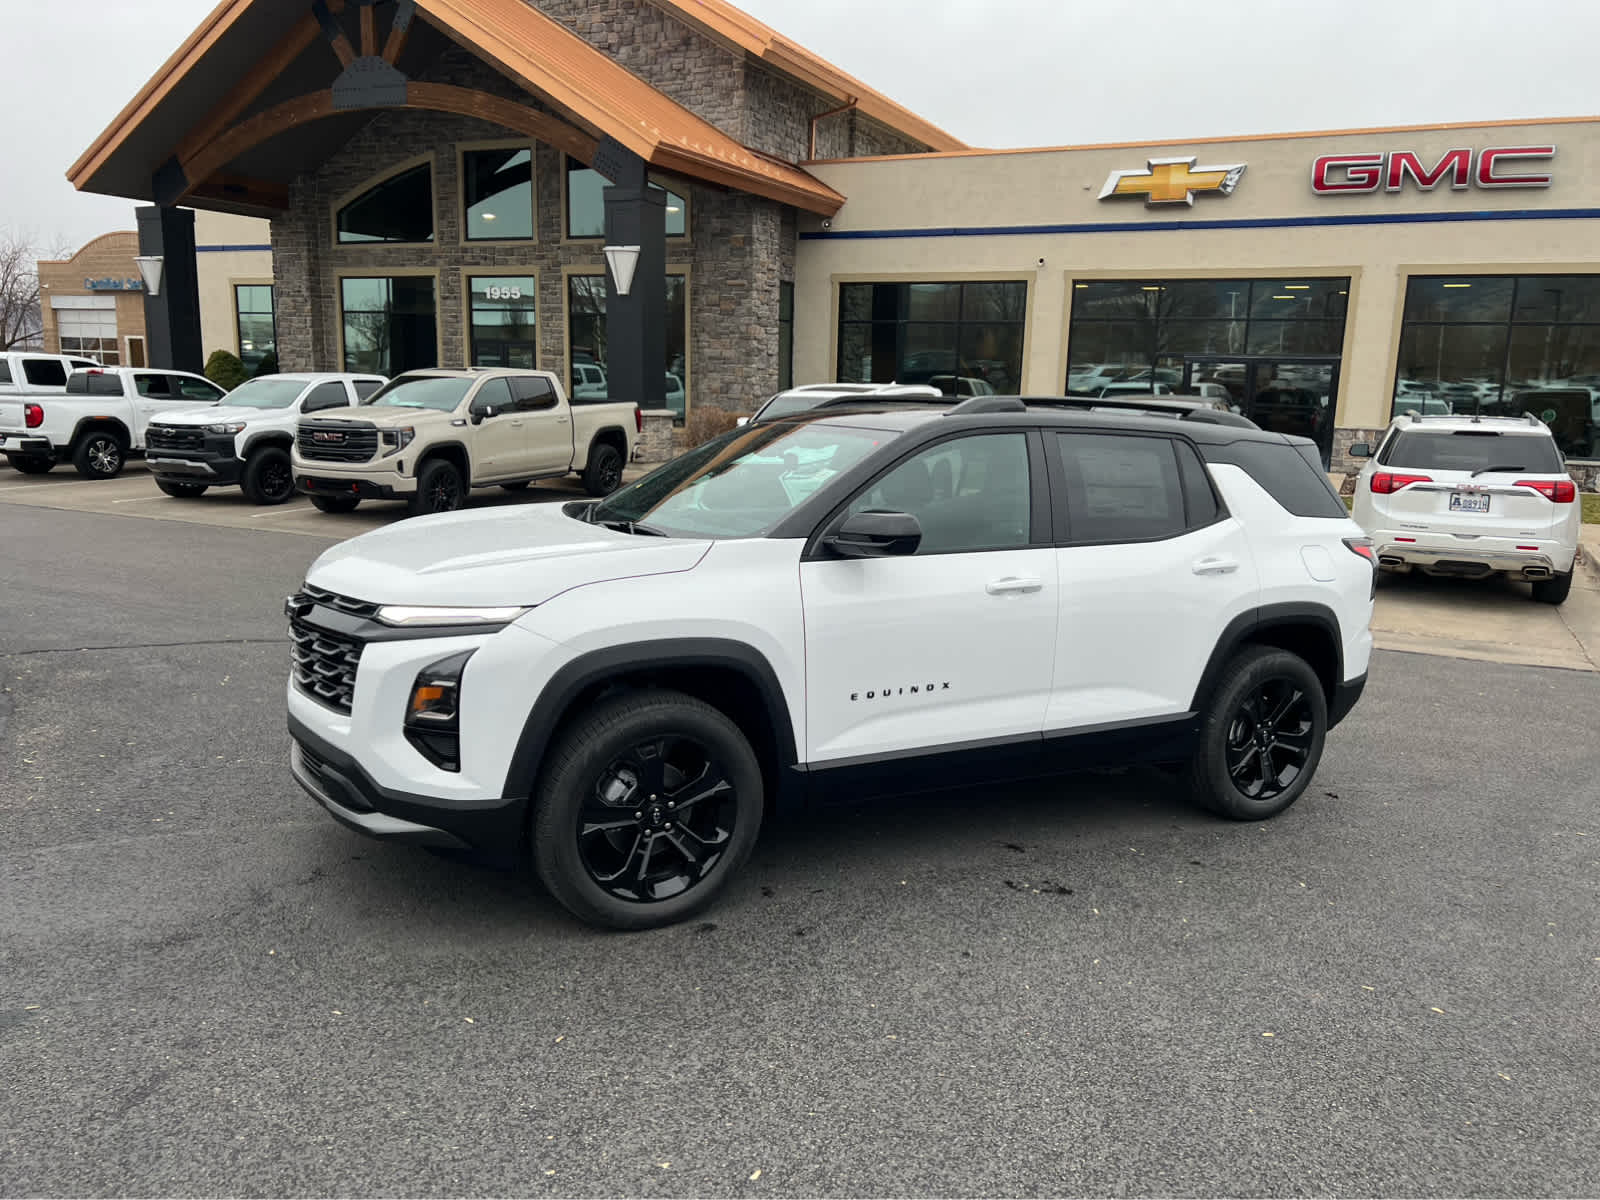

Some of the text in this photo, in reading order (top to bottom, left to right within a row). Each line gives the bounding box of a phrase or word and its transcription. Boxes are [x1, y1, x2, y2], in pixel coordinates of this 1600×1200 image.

[1311, 145, 1556, 195] GMC
[485, 286, 521, 299] 1955
[312, 432, 344, 441] GMC
[850, 682, 950, 701] EQUINOX
